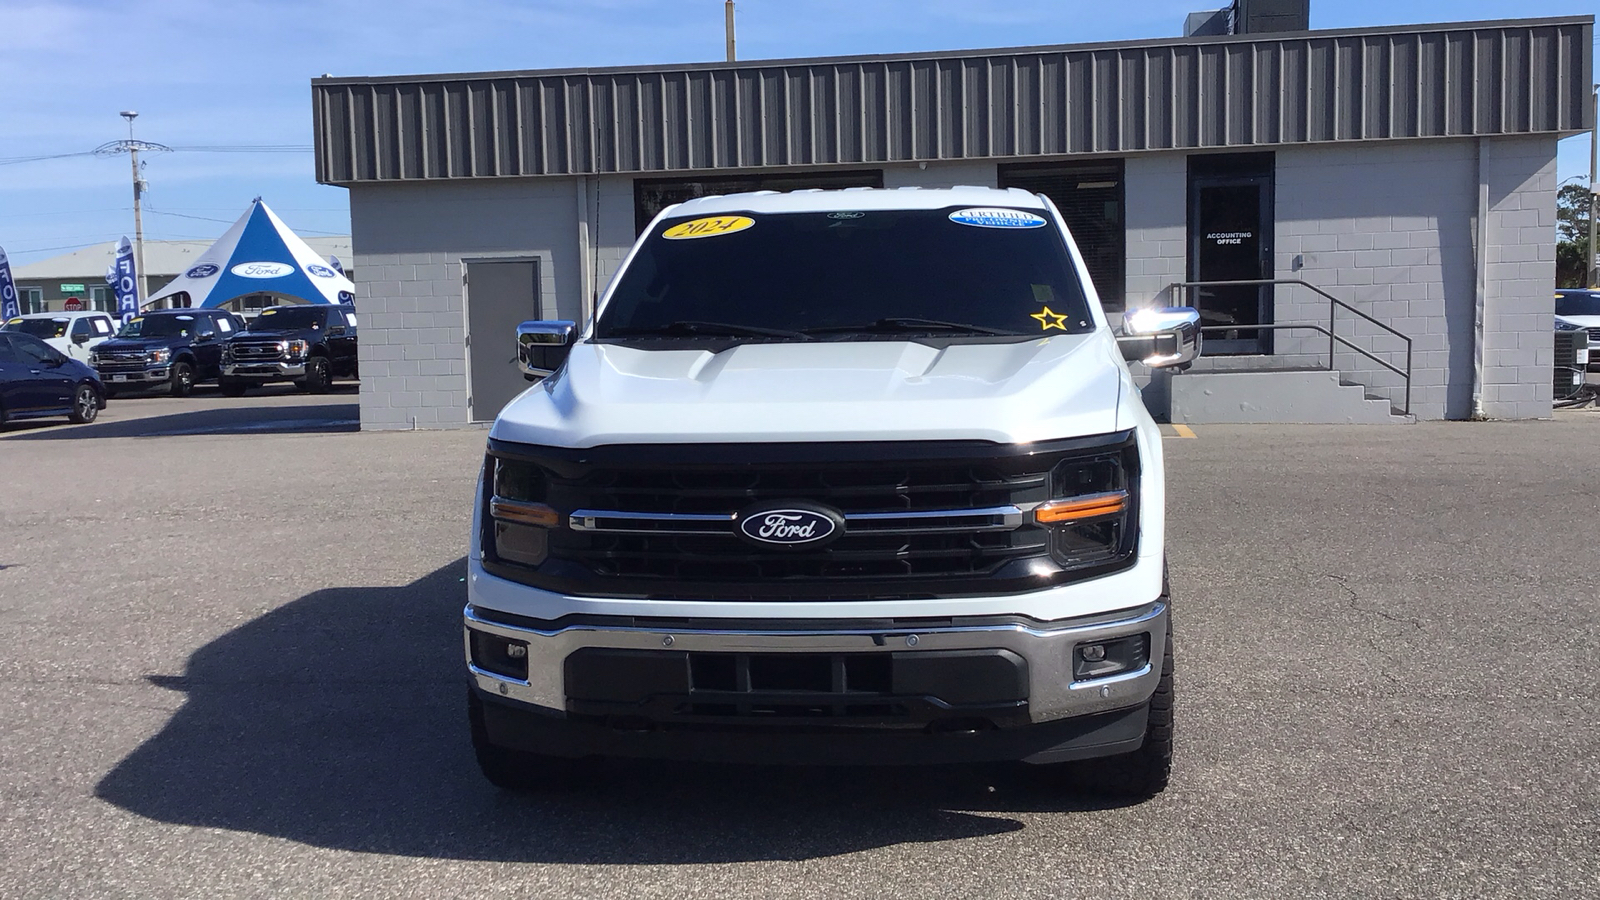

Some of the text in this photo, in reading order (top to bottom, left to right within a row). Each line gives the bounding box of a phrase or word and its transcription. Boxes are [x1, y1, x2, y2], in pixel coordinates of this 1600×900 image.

[960, 211, 1034, 220] CERTIFIED
[673, 217, 740, 236] 2024
[190, 265, 215, 277] Ford
[244, 265, 281, 275] Ford
[65, 303, 82, 312] STOP
[759, 514, 817, 537] Ford
